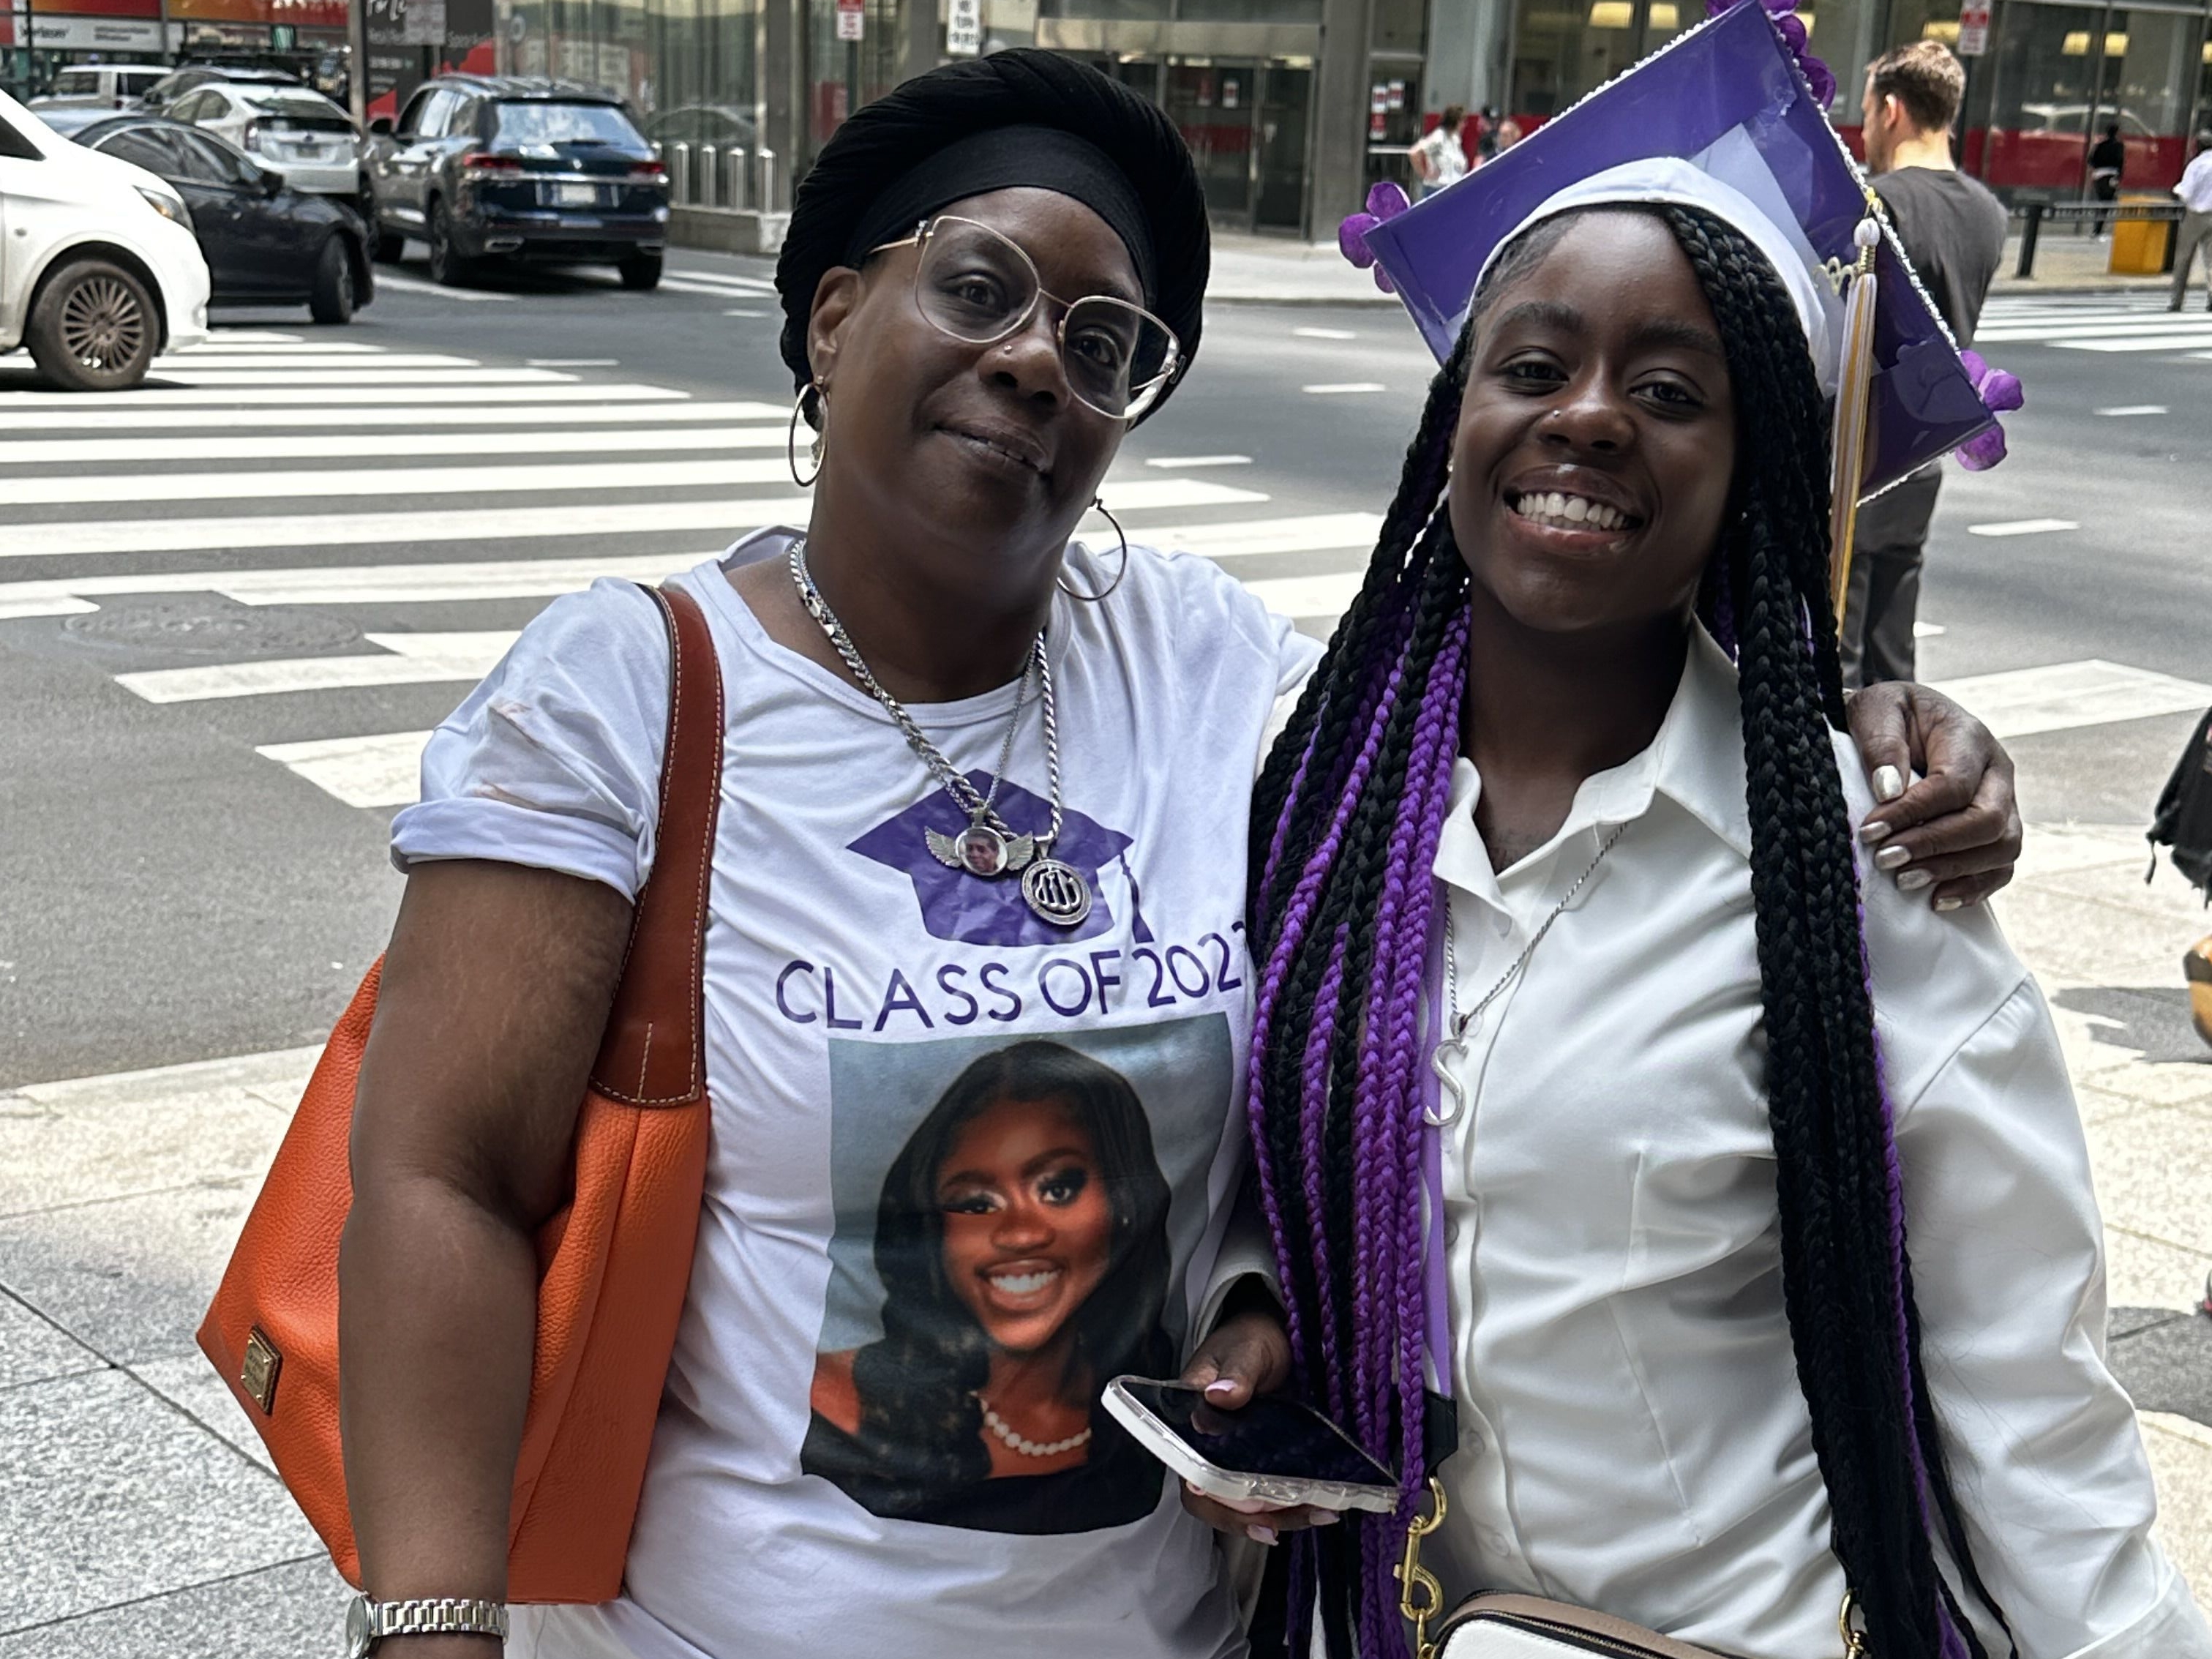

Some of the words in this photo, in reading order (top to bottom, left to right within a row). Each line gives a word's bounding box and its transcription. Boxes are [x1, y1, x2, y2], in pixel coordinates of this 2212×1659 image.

[776, 960, 1022, 1032] CLASS
[1038, 950, 1122, 1016] OF
[1131, 920, 1245, 1008] 202
